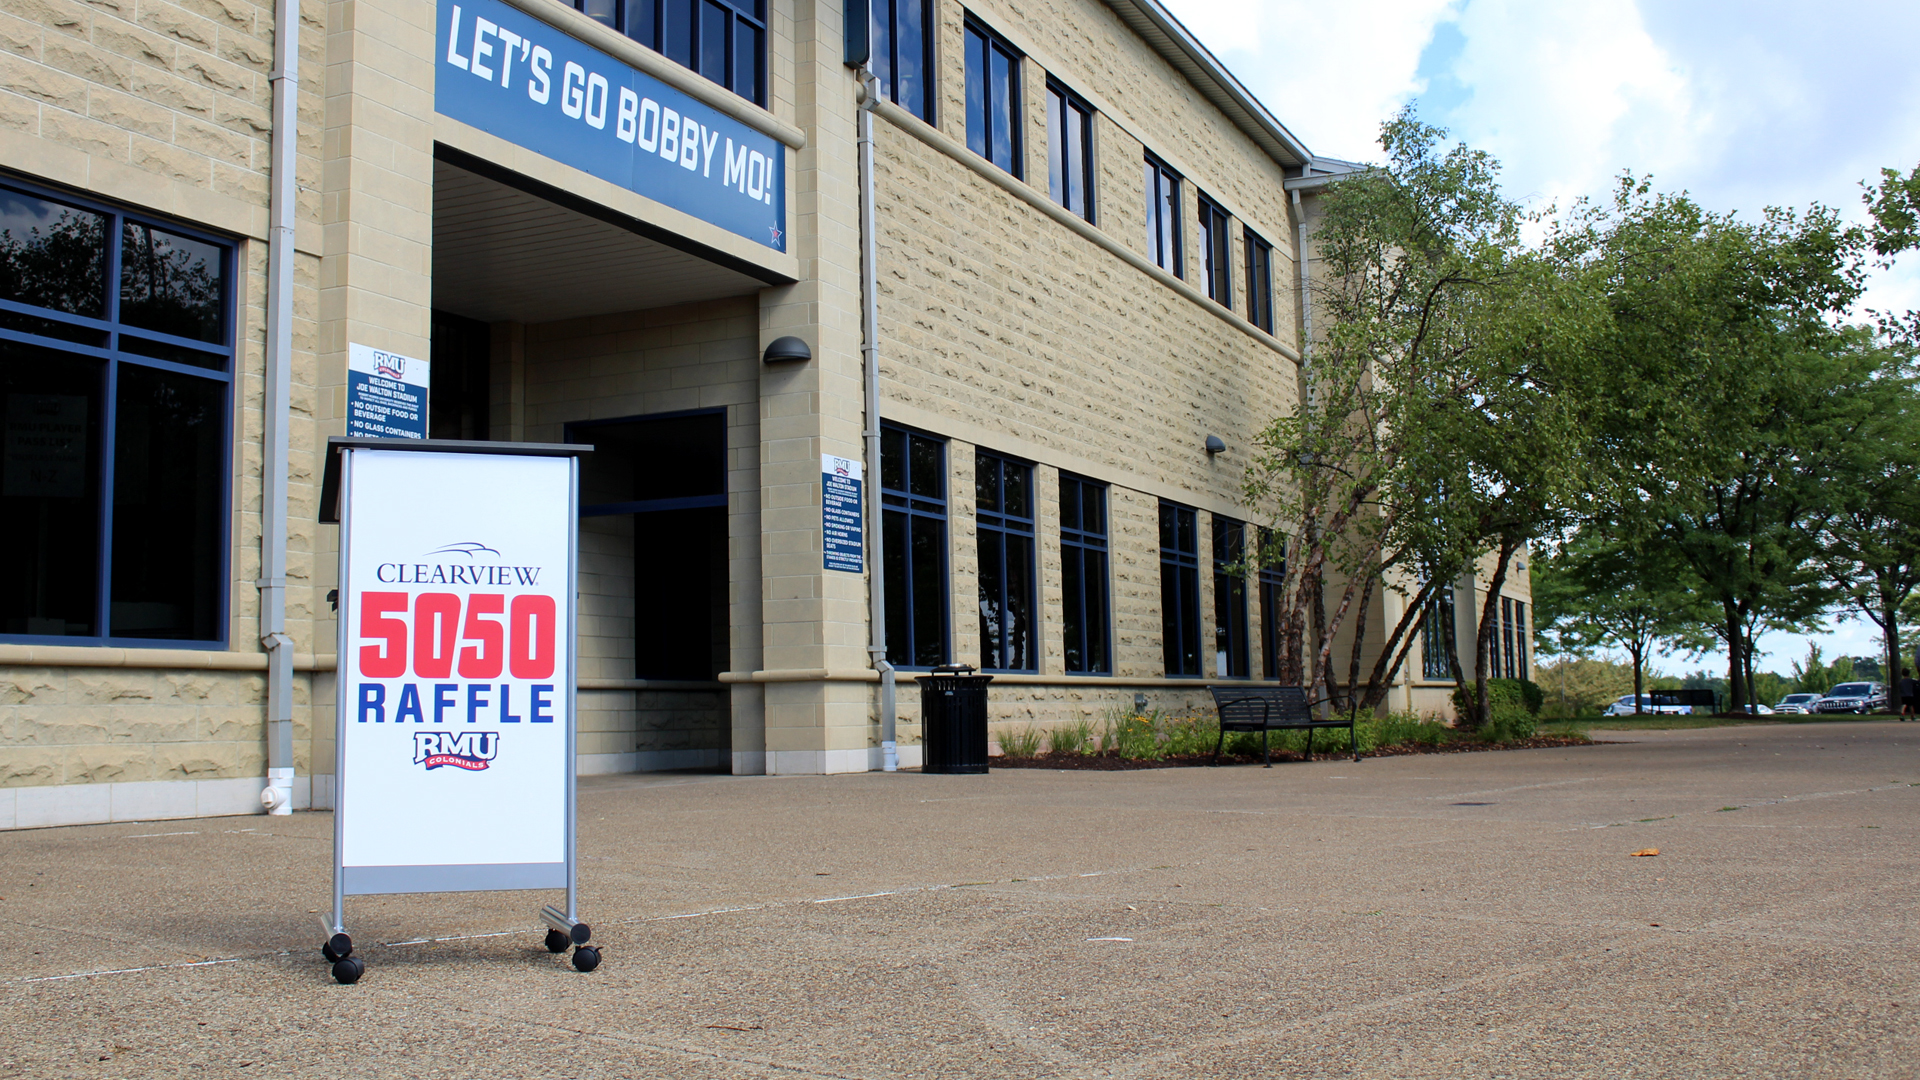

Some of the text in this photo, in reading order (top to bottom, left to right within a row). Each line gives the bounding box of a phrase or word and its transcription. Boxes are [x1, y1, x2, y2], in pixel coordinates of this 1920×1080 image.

[447, 4, 773, 205] LET'S GO BOBBY MO!
[374, 351, 405, 375] RMU
[368, 376, 405, 392] WELCOME TO
[356, 383, 368, 392] JOE
[369, 385, 392, 398] WALTON
[393, 390, 418, 403] STADIUM
[354, 401, 364, 409] NO
[365, 403, 391, 415] OUTSIDE
[392, 408, 408, 419] FOOD
[409, 413, 418, 421] OR
[354, 409, 386, 422] BEVERAGE
[39, 423, 82, 433] PLAYER
[354, 420, 422, 439] NO GLASS CONTAINERS
[17, 436, 74, 447] PASS LIST
[834, 457, 850, 472] RMU
[30, 469, 58, 483] N-Z
[825, 499, 842, 507] BEVERAGE
[830, 494, 843, 502] OUTSIDE
[839, 516, 854, 524] ALLOWED
[841, 509, 860, 518] CONTAINERS
[831, 522, 845, 530] SMOKING
[826, 542, 836, 550] SEATS
[376, 562, 541, 586] CLEARVIEW
[358, 682, 554, 723] RAFFLE
[413, 731, 500, 765] RMU
[429, 756, 485, 769] COLONIALS
